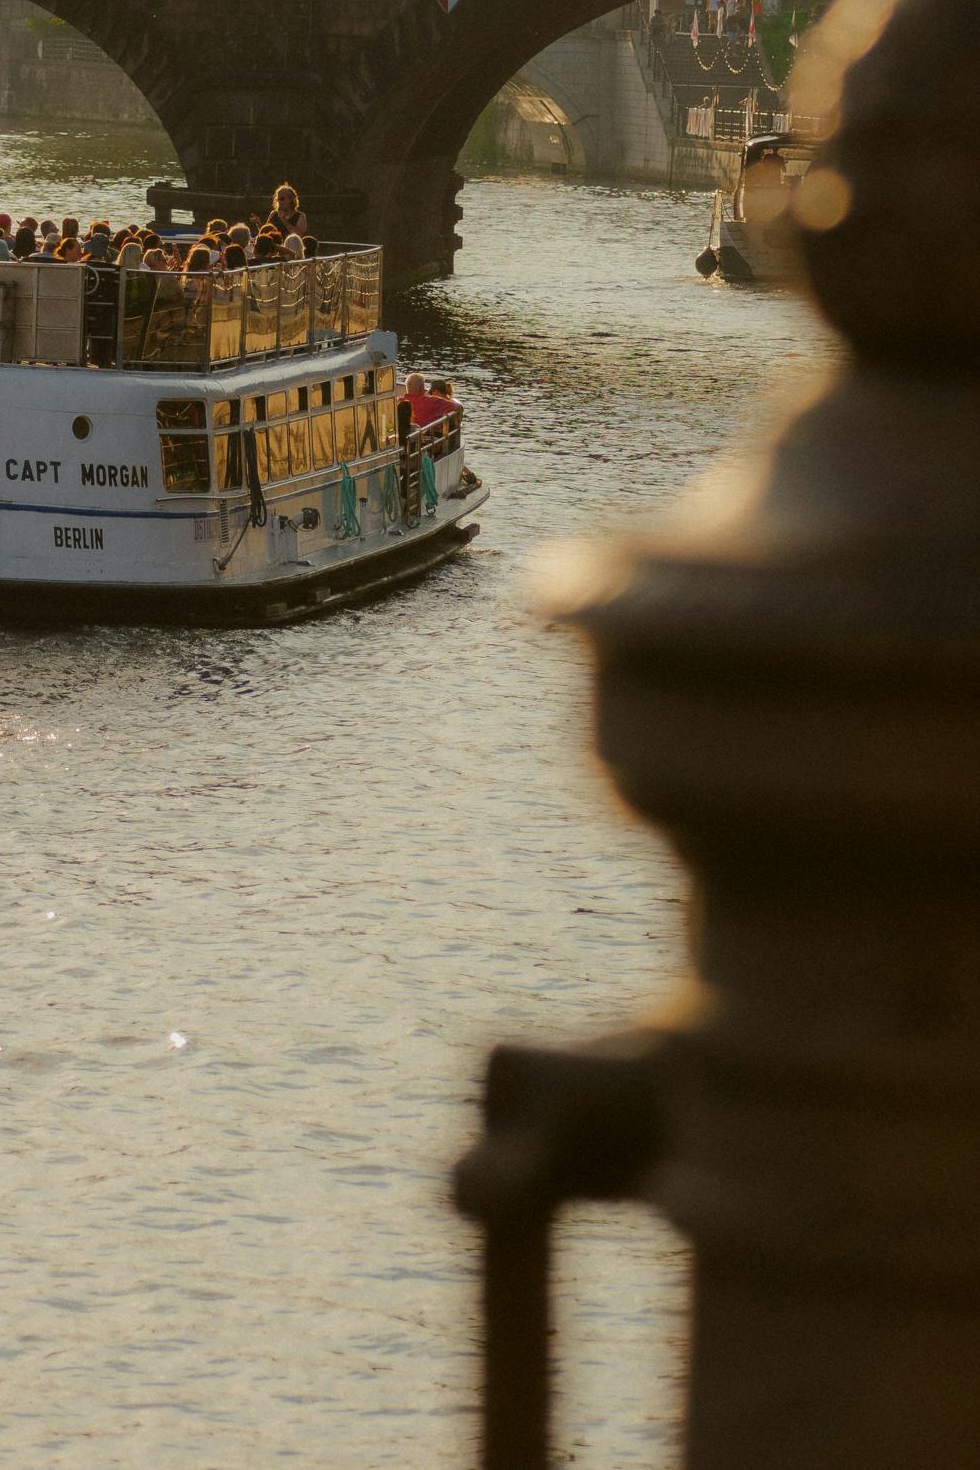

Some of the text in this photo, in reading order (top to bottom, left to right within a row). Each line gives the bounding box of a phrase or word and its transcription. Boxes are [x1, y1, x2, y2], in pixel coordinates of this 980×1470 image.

[5, 458, 149, 488] CAPT MORGAN
[53, 526, 104, 550] BERLIN
